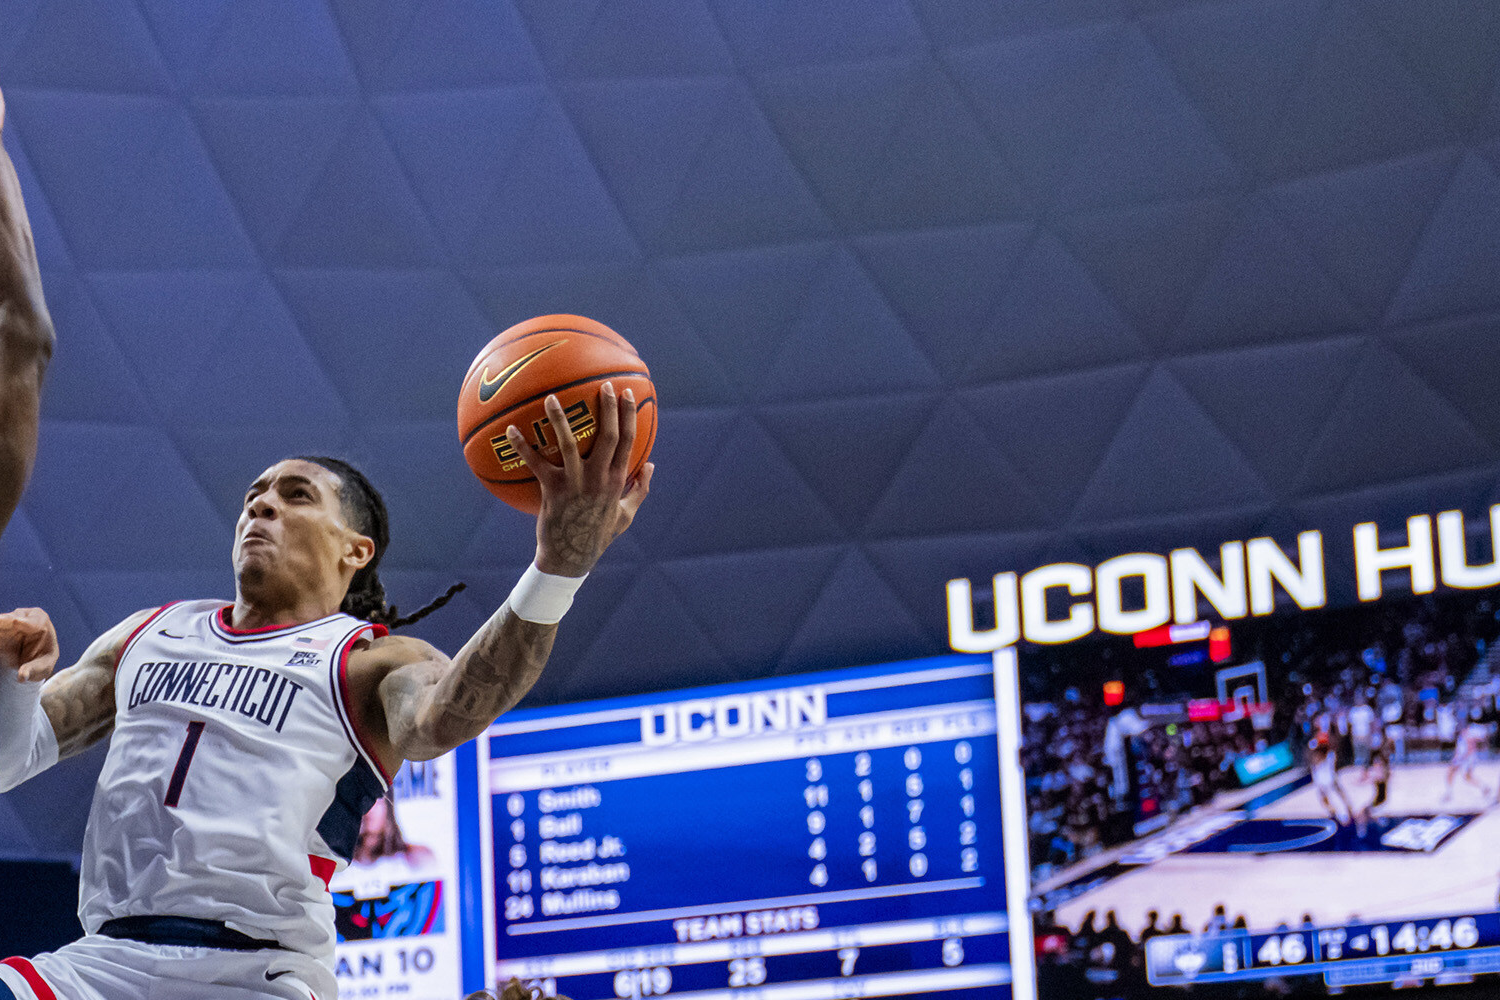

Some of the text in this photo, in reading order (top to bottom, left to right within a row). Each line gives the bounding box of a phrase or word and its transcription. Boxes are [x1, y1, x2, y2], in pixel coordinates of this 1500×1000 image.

[946, 529, 1327, 654] UCONN
[128, 661, 304, 733] CONNECTICUT
[641, 686, 827, 747] UCONN
[164, 720, 206, 808] 1
[538, 785, 601, 813] Smith
[806, 757, 822, 782] 3
[855, 752, 871, 777] 2
[510, 818, 525, 842] 1
[803, 784, 828, 808] 11
[858, 779, 873, 802] 1
[959, 768, 973, 791] 1
[539, 837, 596, 864] Reed
[859, 805, 874, 828] 1
[906, 799, 924, 823] 7
[960, 794, 974, 817] 1
[505, 894, 534, 920] 24
[541, 889, 620, 916] Mullins
[809, 863, 828, 887] 4
[861, 858, 877, 882] 1
[961, 847, 978, 872] 2
[507, 869, 532, 893] 11
[540, 861, 630, 890] Karaban
[808, 836, 827, 861] 4
[858, 831, 876, 856] 2
[959, 820, 977, 845] 2
[674, 905, 820, 942] TEAM STATS
[1258, 932, 1307, 965] 46
[1370, 916, 1480, 956] 14:46
[336, 946, 434, 977] AN 10
[728, 957, 767, 987] 25
[837, 947, 860, 976] 7
